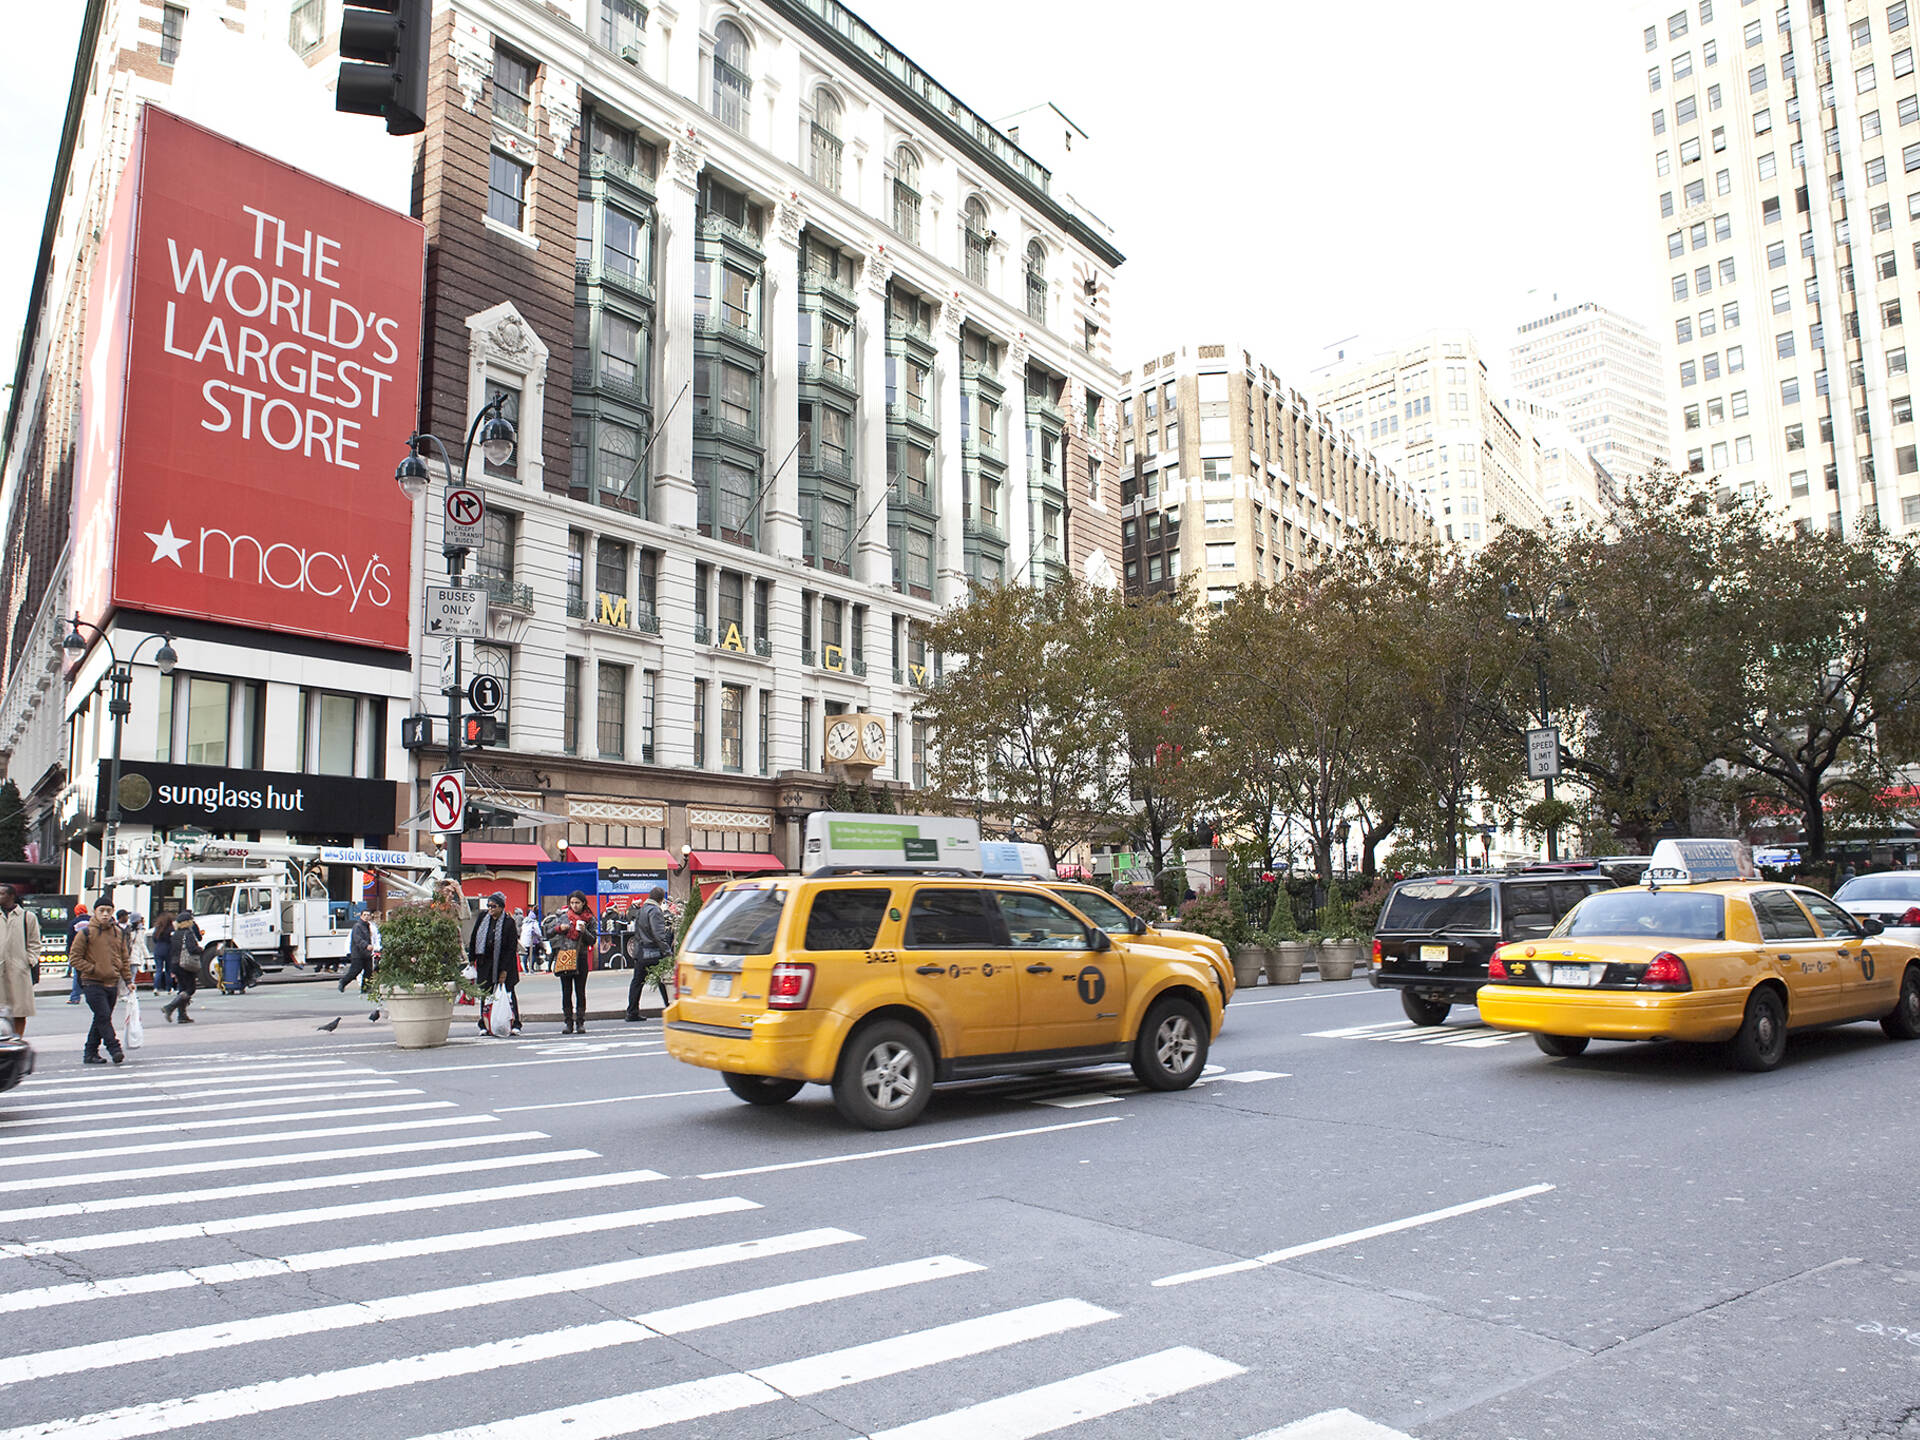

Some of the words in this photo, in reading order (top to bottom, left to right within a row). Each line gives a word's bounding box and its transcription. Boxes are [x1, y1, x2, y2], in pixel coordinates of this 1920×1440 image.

[243, 205, 341, 289] THE
[167, 238, 399, 365] WORLD'S
[164, 301, 392, 417] LARGEST
[201, 379, 360, 470] STORE
[199, 526, 391, 613] macy's
[439, 591, 476, 602] BUSES
[442, 604, 471, 615] ONLY
[1531, 740, 1553, 750] SPEED
[1534, 751, 1552, 760] LIMIT
[1538, 762, 1549, 771] 30
[158, 781, 262, 814] sunglass
[266, 784, 304, 811] hut
[340, 850, 362, 861] SIGN
[365, 852, 407, 864] SERVICES
